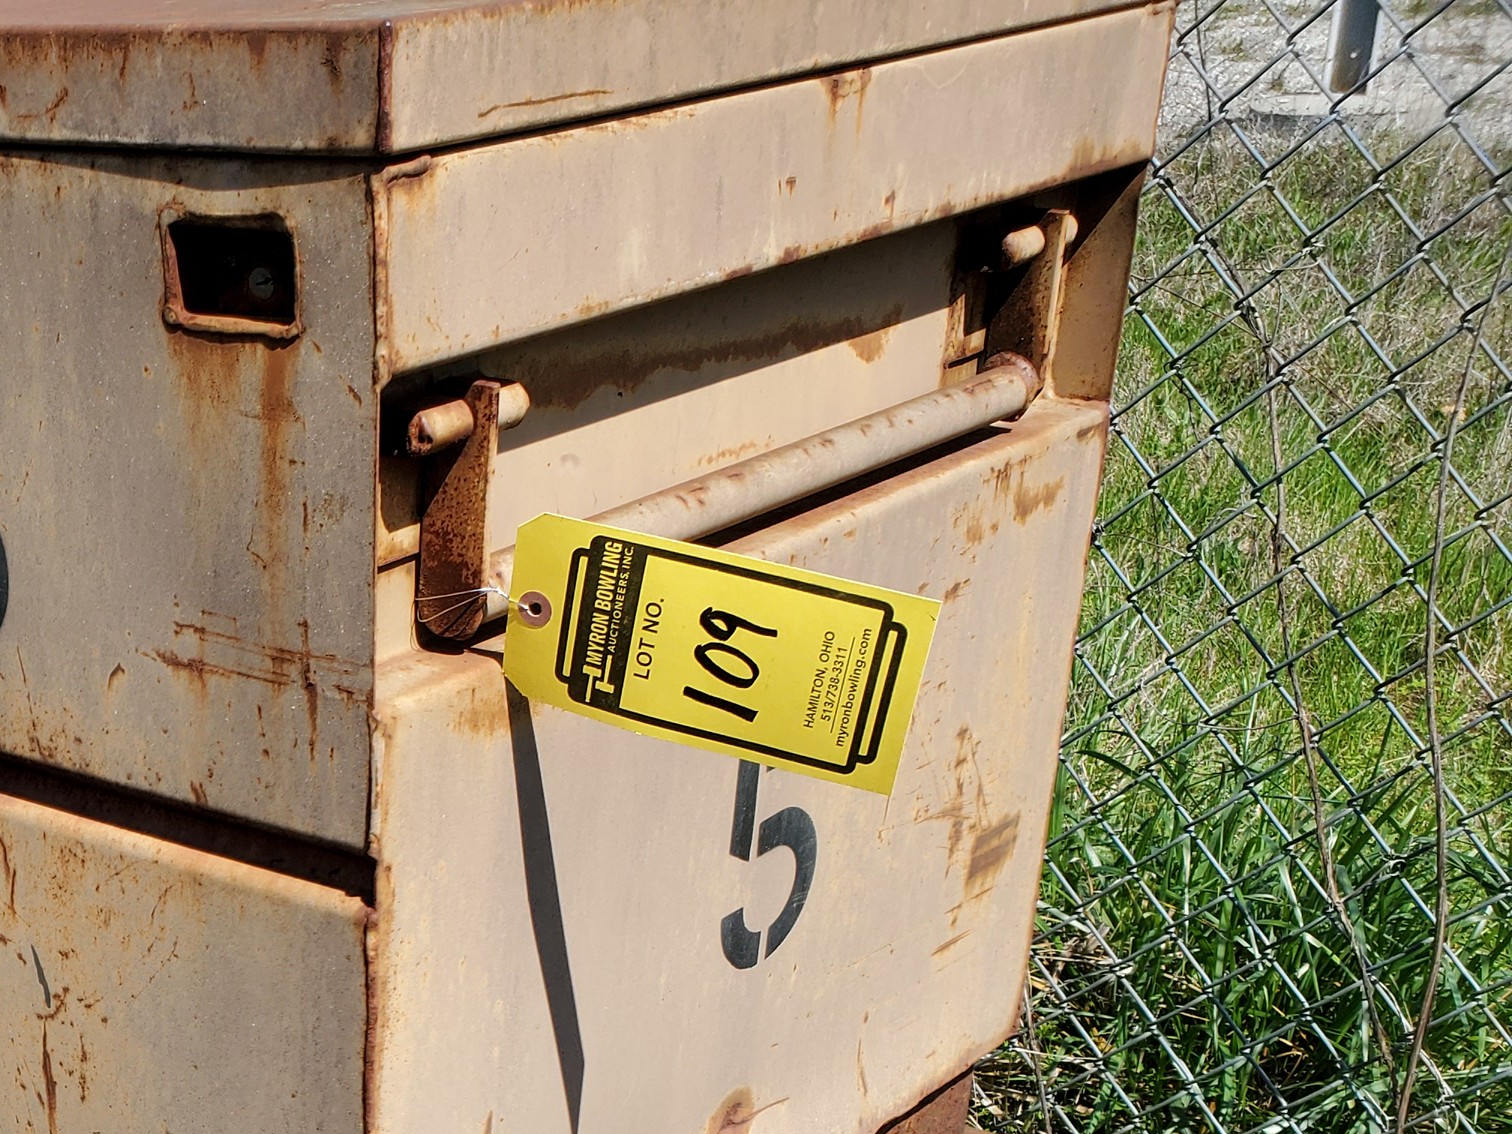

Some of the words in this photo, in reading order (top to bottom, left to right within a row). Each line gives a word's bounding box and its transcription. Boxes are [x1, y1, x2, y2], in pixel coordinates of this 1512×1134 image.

[594, 541, 623, 612] BOWLING
[622, 546, 635, 569] INC.
[586, 613, 609, 666] MYRON
[641, 598, 665, 634] NO.
[633, 637, 656, 680] LOT
[683, 606, 778, 722] 109
[803, 667, 829, 728] HAMILTON,
[819, 631, 835, 663] OHIO
[820, 646, 848, 722] 513/738-3311
[835, 628, 873, 747] myronbowling.com
[720, 758, 817, 970] 5
